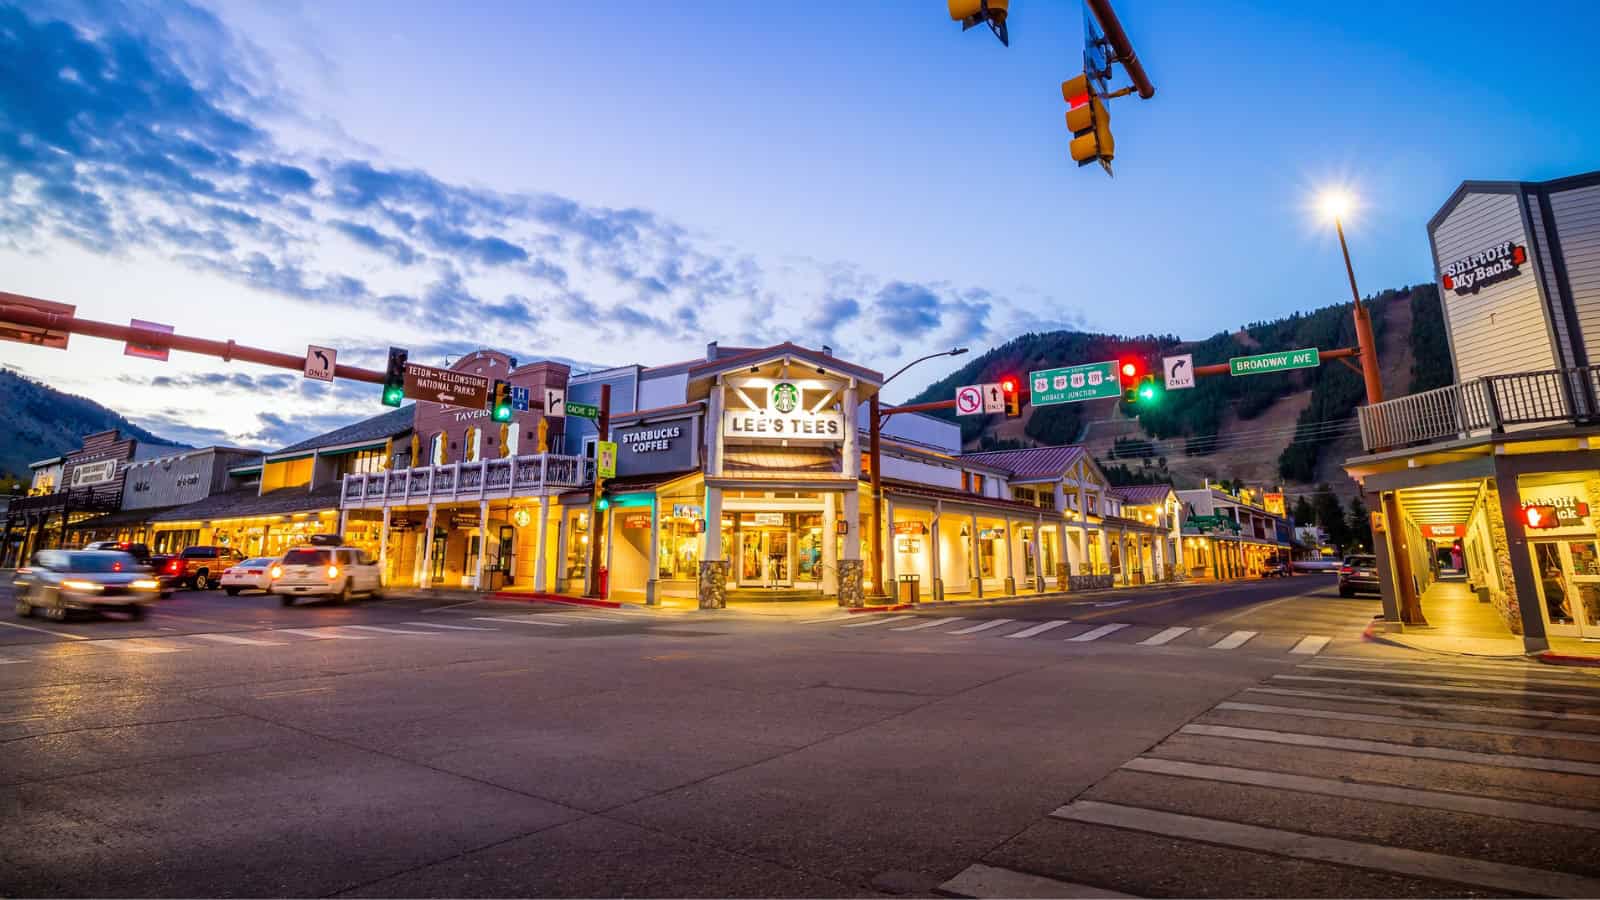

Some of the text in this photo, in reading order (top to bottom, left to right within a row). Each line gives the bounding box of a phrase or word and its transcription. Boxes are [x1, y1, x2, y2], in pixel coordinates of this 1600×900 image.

[1447, 241, 1511, 276] ShirtOff
[1452, 258, 1513, 288] MyBack
[1236, 353, 1311, 371] BROADWAY AVE
[309, 369, 329, 378] ONLY
[408, 366, 487, 388] TETON-YELLOWSTONE
[417, 379, 476, 397] NATIONAL PARKS
[1169, 378, 1190, 386] ONLY
[518, 388, 525, 398] H
[1069, 389, 1097, 399] JUNCTION
[732, 417, 838, 434] LEE'S TEES
[622, 427, 680, 443] STARBUCKS
[632, 439, 669, 452] COFFEE
